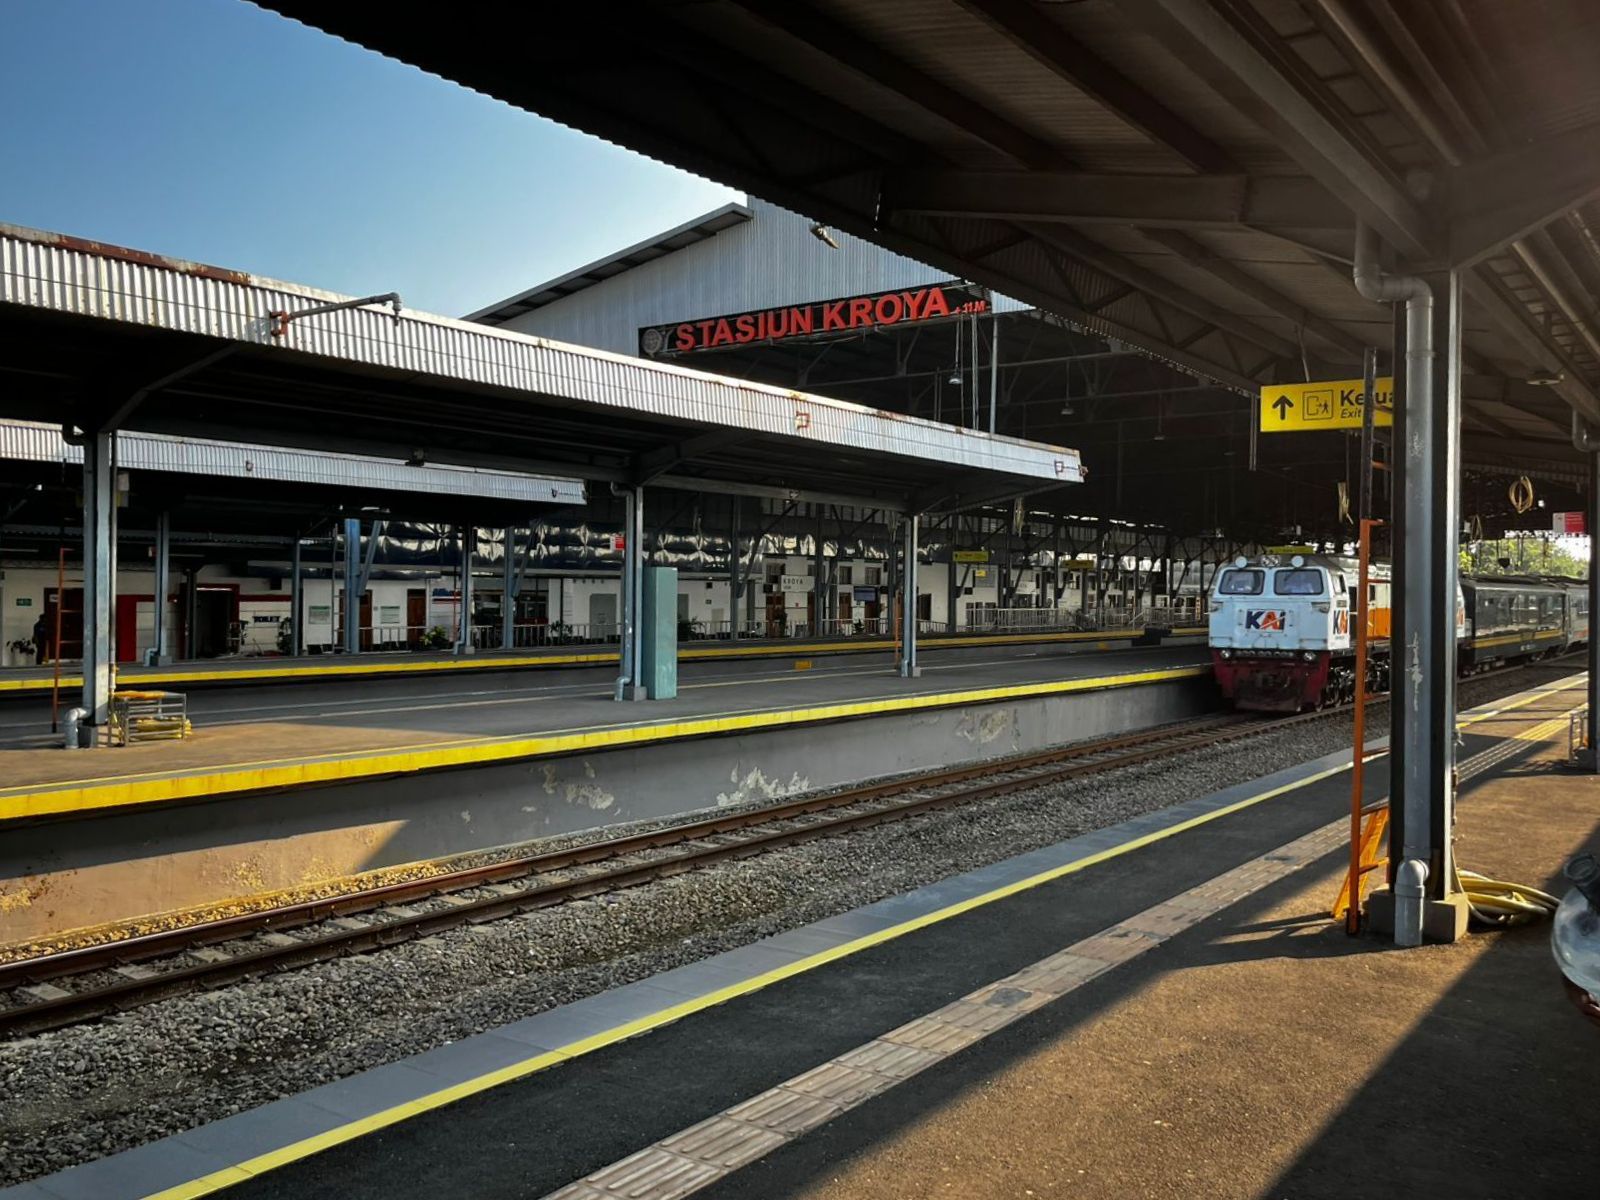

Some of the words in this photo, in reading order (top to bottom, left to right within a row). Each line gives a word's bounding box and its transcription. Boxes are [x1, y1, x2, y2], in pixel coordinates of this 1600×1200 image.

[675, 305, 812, 351] STASIUN
[822, 287, 949, 331] KROYA
[1340, 408, 1362, 419] Exit
[1245, 610, 1286, 631] KAI
